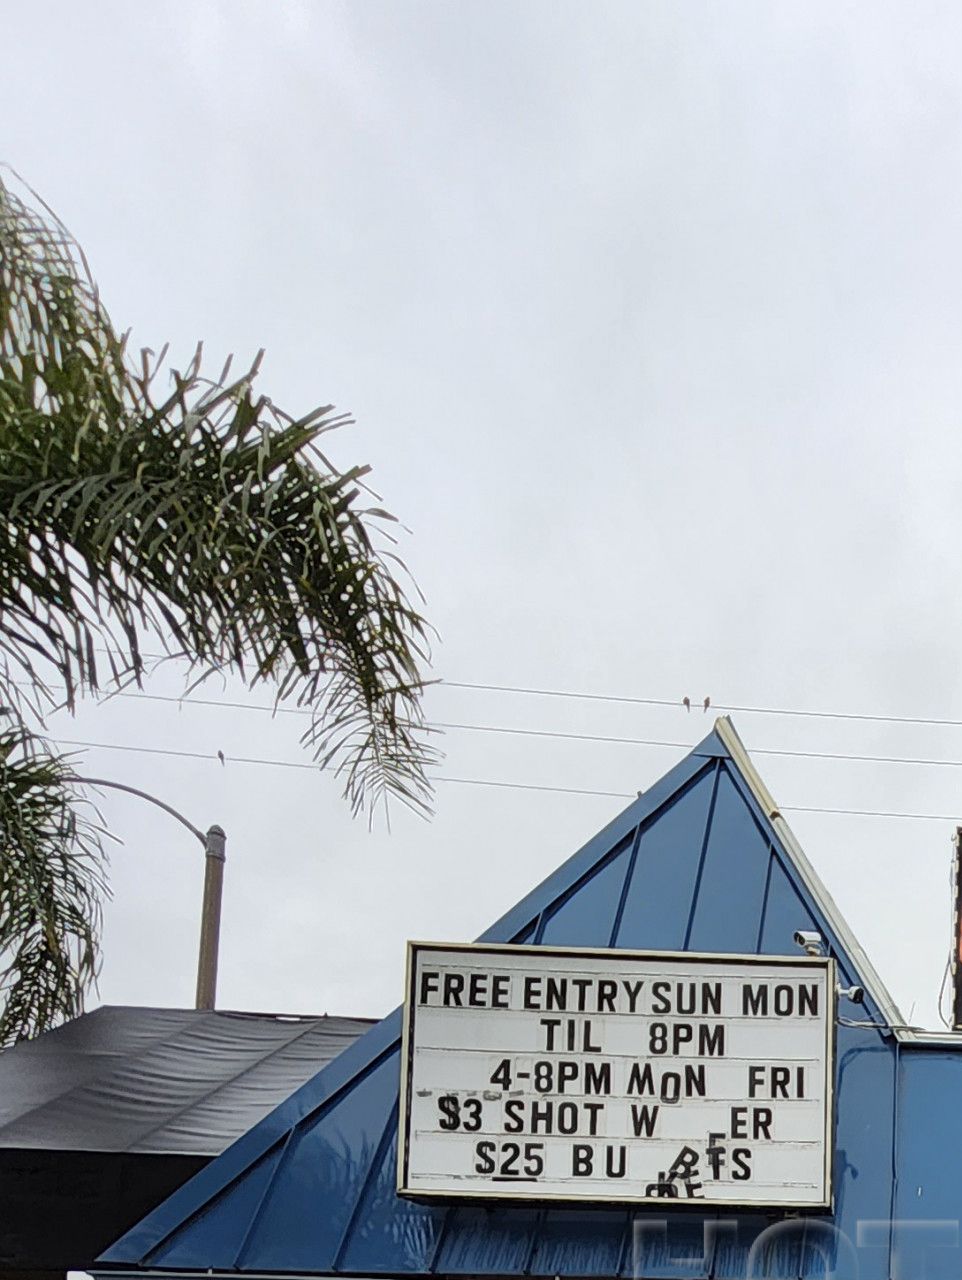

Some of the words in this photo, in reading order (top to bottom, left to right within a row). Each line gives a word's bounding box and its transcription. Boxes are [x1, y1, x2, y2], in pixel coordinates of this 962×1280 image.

[421, 971, 511, 1009] FREE
[523, 976, 644, 1014] ENTRY
[651, 981, 722, 1015] SUN
[742, 984, 819, 1016] MON
[541, 1018, 602, 1052] TIL
[649, 1022, 725, 1056] 8PM
[490, 1059, 611, 1095] 4-8PM
[627, 1063, 706, 1104] MON
[749, 1066, 806, 1098] FRI
[438, 1094, 482, 1131] $3
[504, 1100, 604, 1136] SHOT
[475, 1141, 544, 1177] $25
